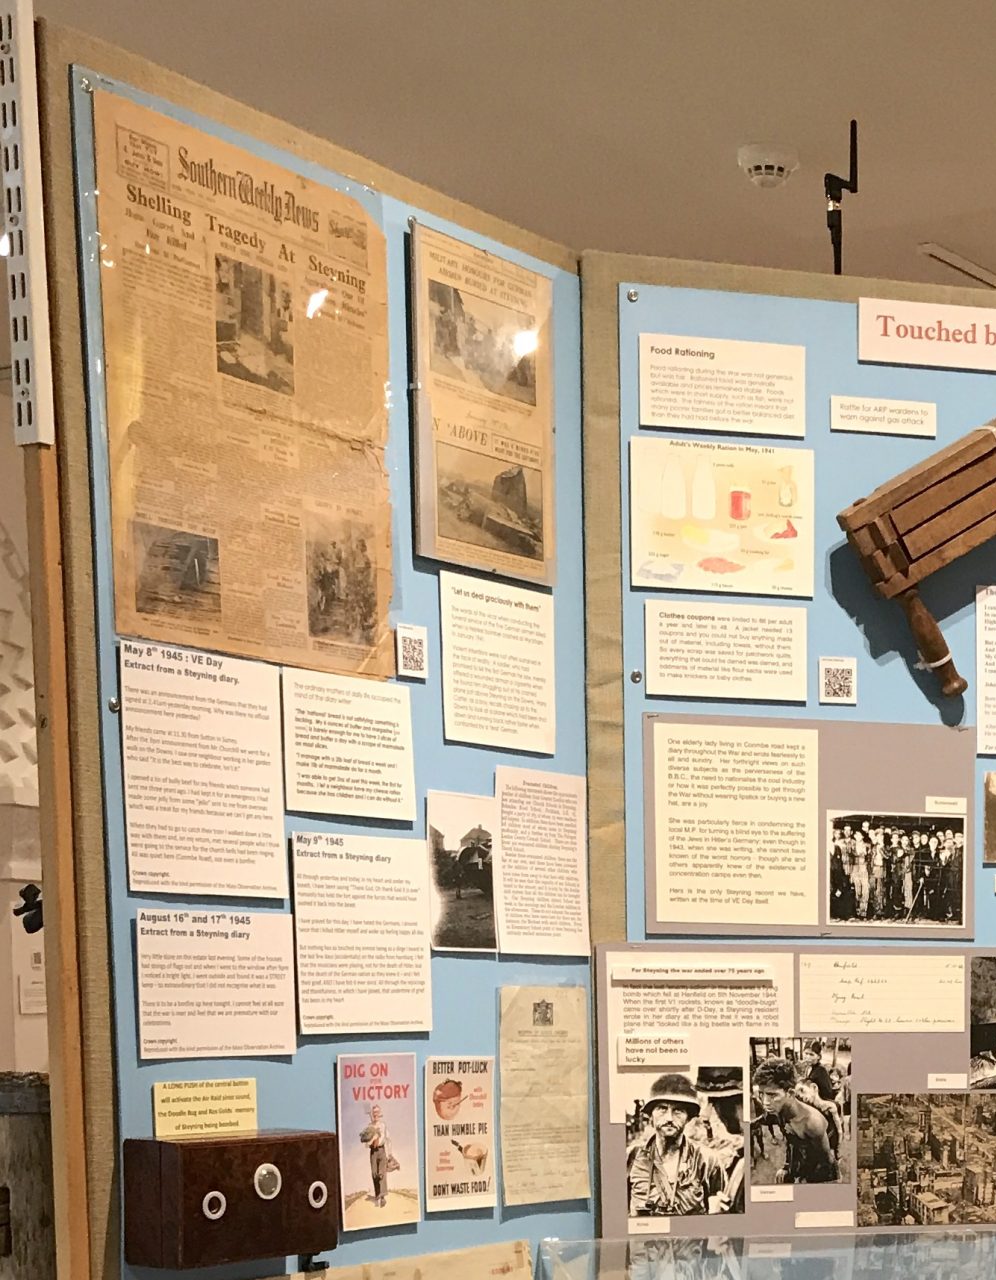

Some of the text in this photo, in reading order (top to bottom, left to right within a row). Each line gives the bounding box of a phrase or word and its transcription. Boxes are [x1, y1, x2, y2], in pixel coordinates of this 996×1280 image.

[178, 146, 237, 201] Southern
[236, 171, 283, 224] Weekly
[285, 190, 319, 232] News
[126, 184, 191, 226] Shelling
[205, 213, 265, 253] Tragedy
[278, 245, 296, 263] At
[308, 255, 365, 293] Steyning
[876, 315, 977, 345] Touched
[650, 346, 715, 360] Food Rationing
[124, 644, 143, 658] May
[161, 650, 183, 662] 1945
[191, 655, 204, 665] VE
[206, 657, 223, 669] Day
[124, 660, 154, 672] Extract
[157, 665, 175, 674] from
[184, 668, 217, 683] Steyning
[297, 835, 311, 847] May
[325, 837, 344, 846] 1945
[433, 1061, 488, 1074] BETTER POT-LUCK
[626, 1056, 645, 1064] lucky
[344, 1063, 388, 1079] DIG ON
[352, 1084, 410, 1101] VICTORY
[433, 1123, 487, 1136] THAN HUMBLE PIE
[451, 1183, 469, 1194] WASTE
[471, 1176, 491, 1193] FOOD!
